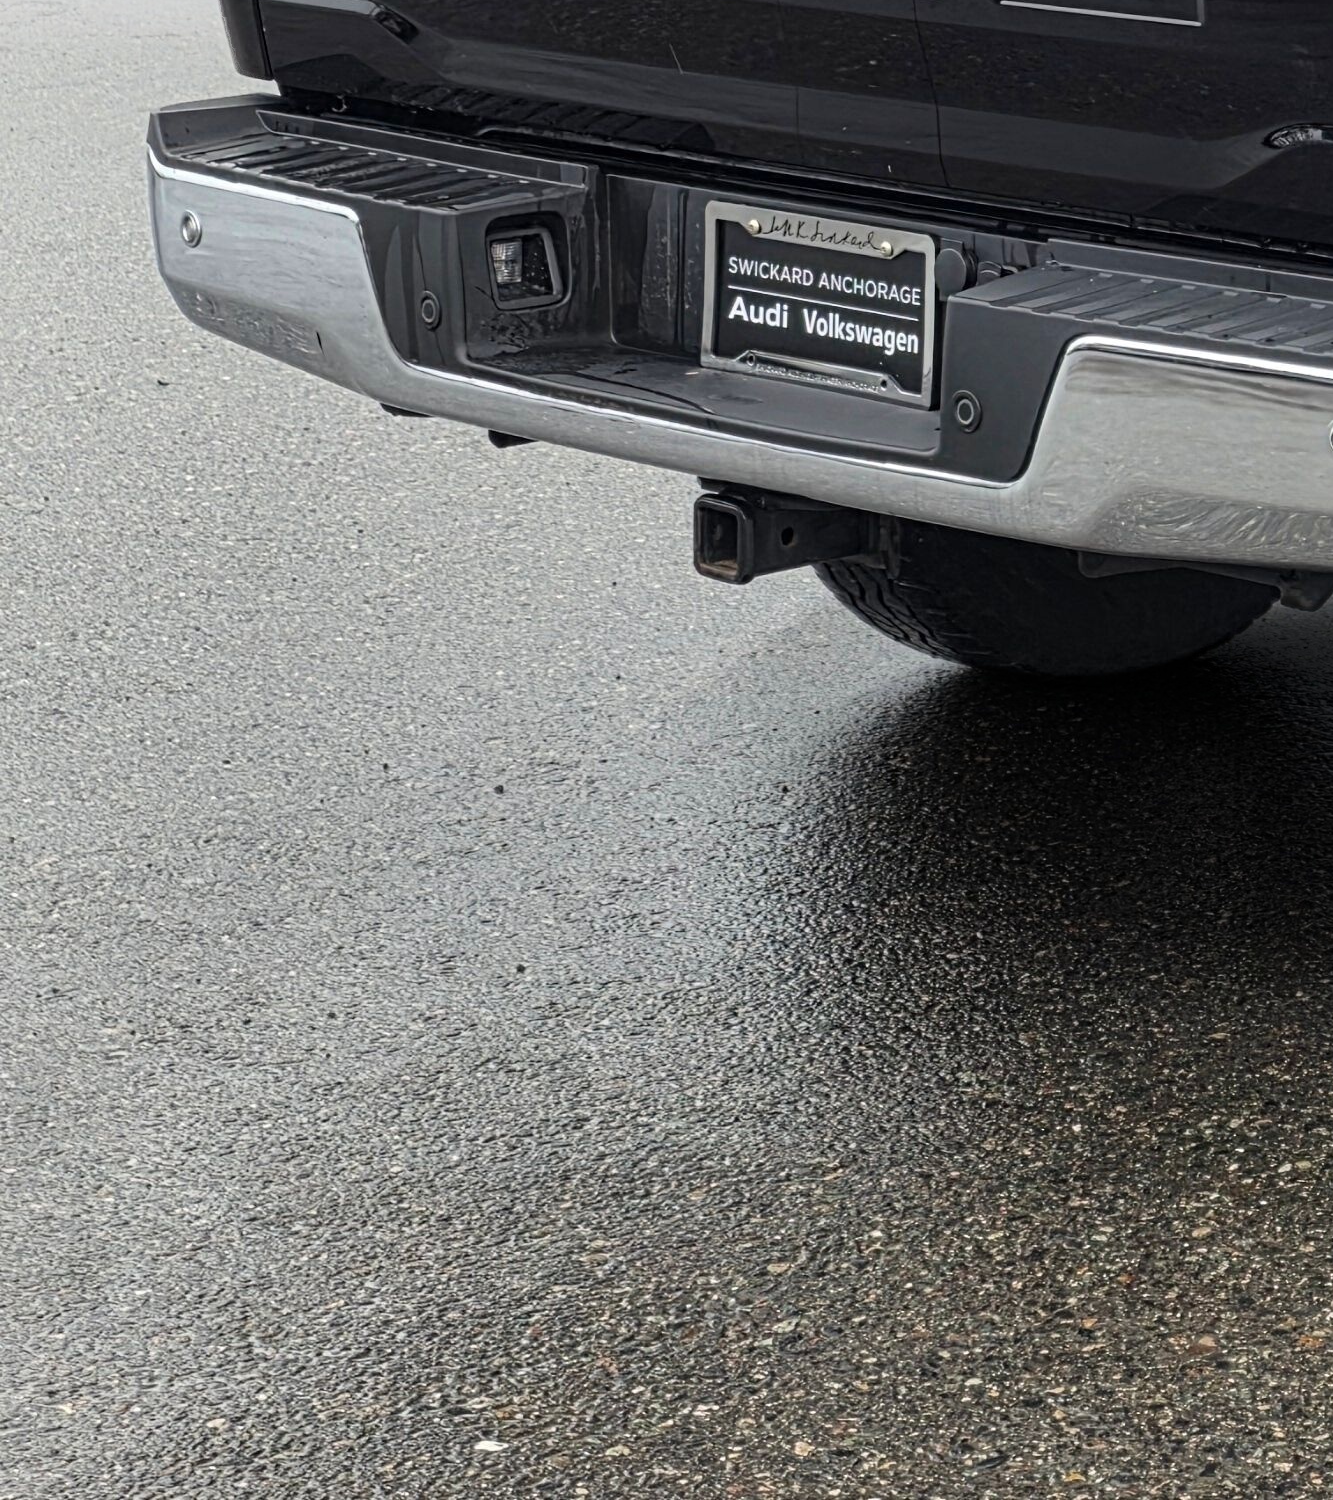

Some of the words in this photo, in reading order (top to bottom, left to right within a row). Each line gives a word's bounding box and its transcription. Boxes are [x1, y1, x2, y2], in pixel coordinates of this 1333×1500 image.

[728, 256, 814, 286] SWICKARD
[818, 272, 922, 306] ANCHORAGE
[728, 296, 788, 329] Audi
[803, 308, 919, 356] Volkswagen
